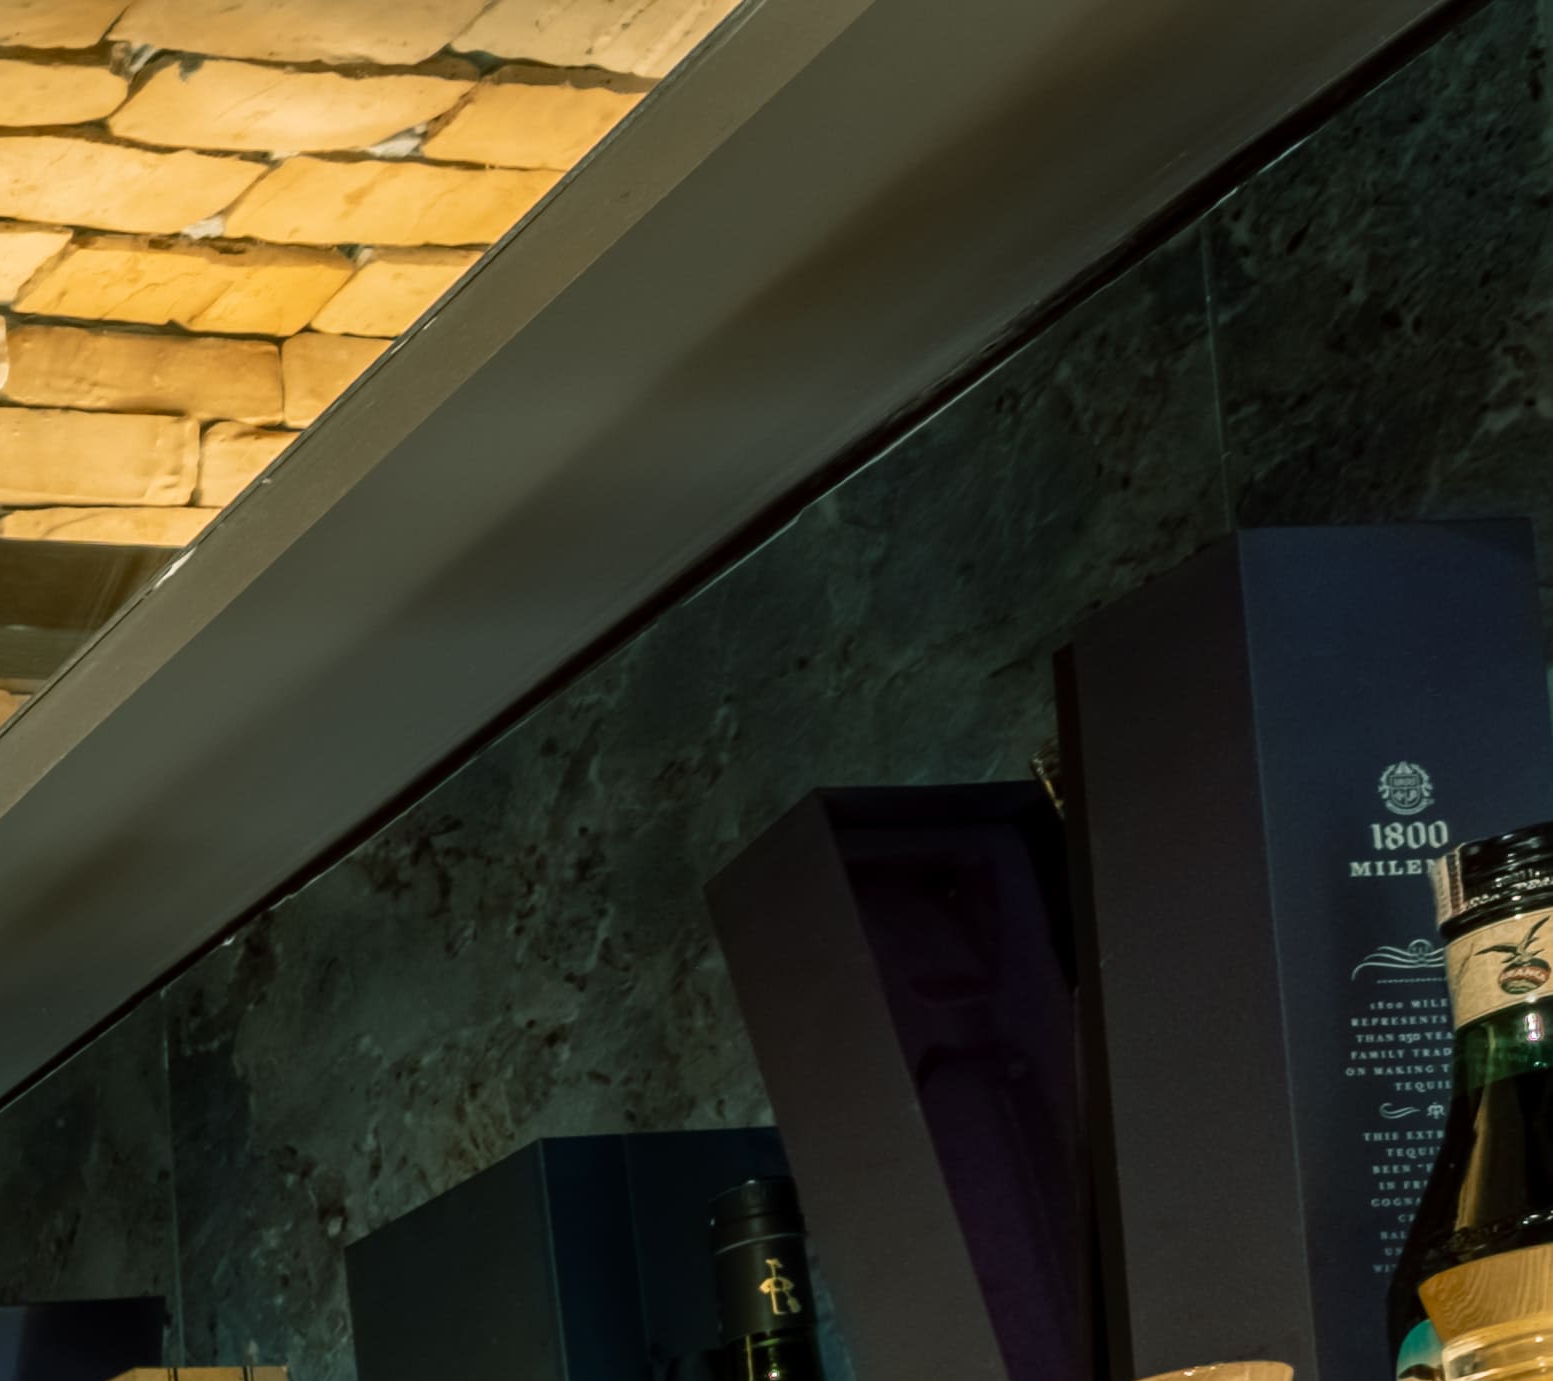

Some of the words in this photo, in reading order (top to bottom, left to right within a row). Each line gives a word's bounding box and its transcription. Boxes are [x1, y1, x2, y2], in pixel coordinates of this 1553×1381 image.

[1370, 820, 1449, 850] 1800
[1356, 1033, 1394, 1043] THAN
[1350, 1049, 1405, 1060] FAMILY
[1345, 1066, 1366, 1076] ON
[1374, 1065, 1434, 1076] MAKING
